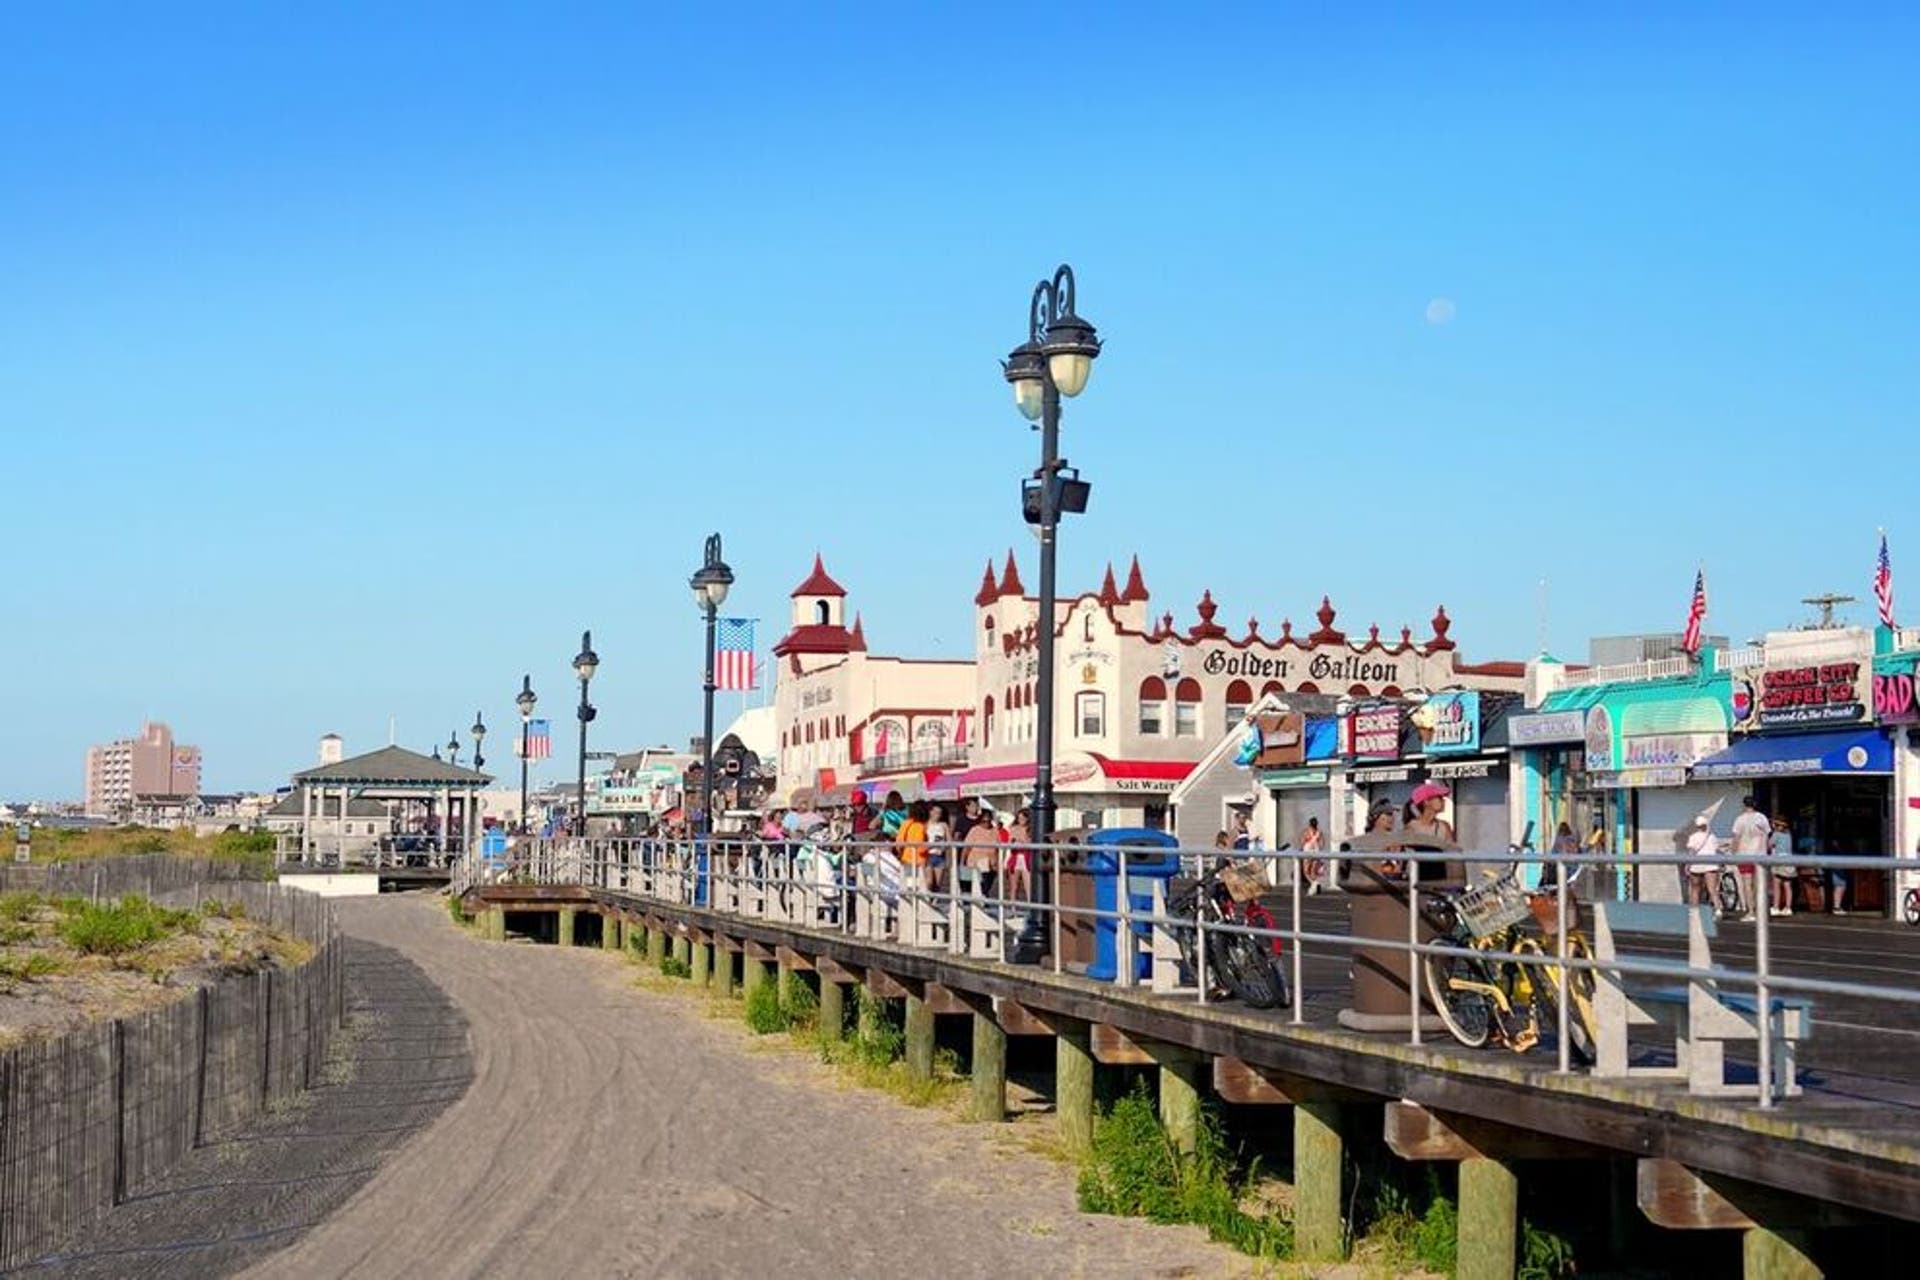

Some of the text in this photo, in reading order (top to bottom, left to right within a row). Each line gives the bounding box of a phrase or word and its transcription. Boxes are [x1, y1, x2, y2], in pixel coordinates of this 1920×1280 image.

[1204, 649, 1398, 682] Golden Galleon
[1764, 687, 1826, 707] COFFEE
[1873, 674, 1912, 713] BAD
[1142, 781, 1175, 790] Water
